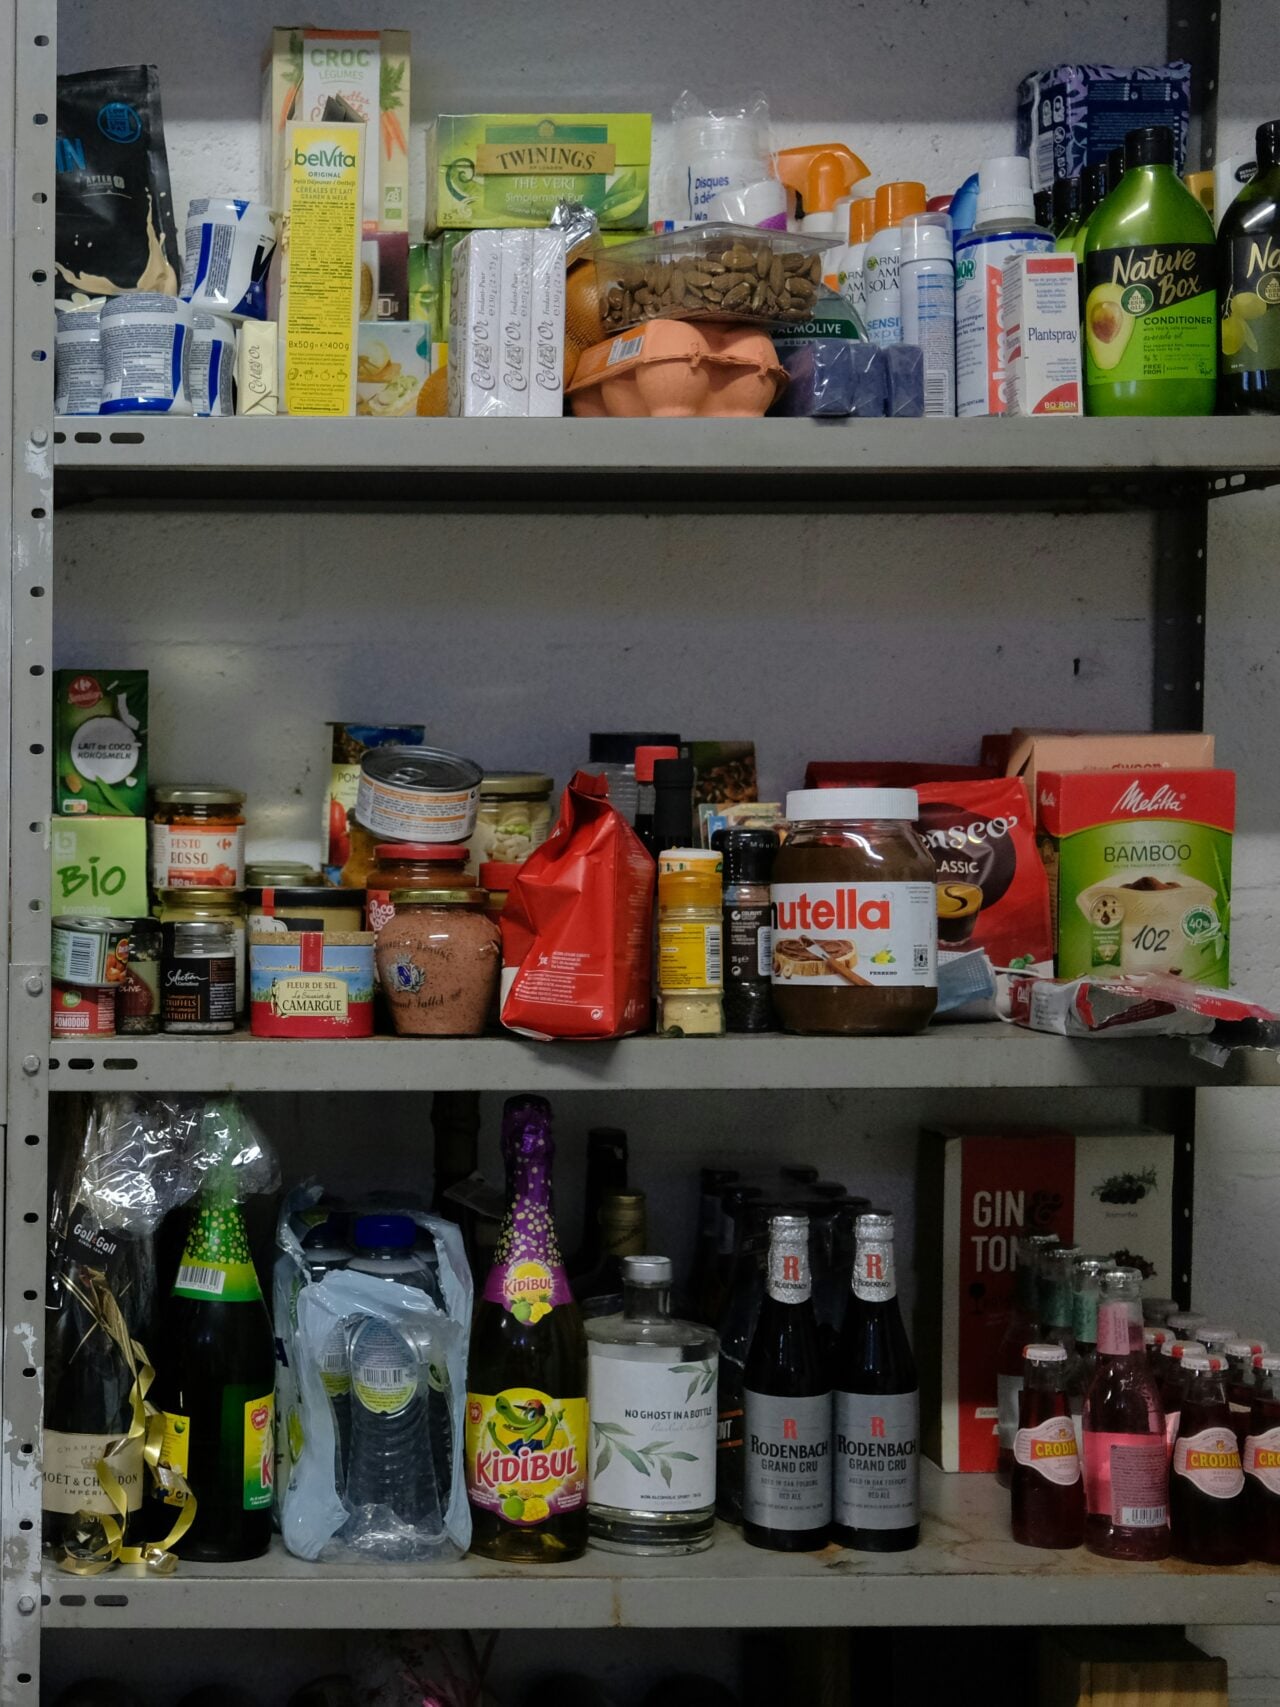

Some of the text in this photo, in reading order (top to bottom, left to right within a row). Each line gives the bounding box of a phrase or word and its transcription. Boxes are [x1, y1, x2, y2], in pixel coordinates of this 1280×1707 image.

[311, 49, 370, 68] CROC
[294, 145, 357, 169] belVita
[496, 144, 597, 171] TWININGS
[542, 176, 577, 189] VERT
[695, 177, 730, 190] Disques
[1112, 248, 1197, 287] Nature
[1159, 273, 1202, 305] Box
[1143, 315, 1213, 326] CONDITIONER
[1027, 327, 1078, 343] Plantspray
[77, 742, 132, 751] LAIT COCO
[77, 751, 132, 760] KOKOSMELK
[1110, 779, 1184, 814] Melitta
[171, 851, 209, 865] ROSSO
[1103, 843, 1192, 863] BAMBOO
[1131, 924, 1171, 951] 102
[286, 981, 338, 989] FLEUR DE SEL
[282, 999, 342, 1012] CAMARGUE
[972, 1189, 1025, 1228] GIN
[783, 1254, 800, 1282] R
[866, 1253, 883, 1280] R
[774, 1280, 808, 1290] RODENBACH
[858, 1279, 892, 1289] RODENBACH
[624, 1406, 712, 1420] NO GHOST IN A BOTTLE
[783, 1418, 798, 1440] R
[870, 1416, 886, 1439] R
[751, 1434, 829, 1459] RODENBACH
[838, 1434, 917, 1457] RODENBACH
[761, 1460, 818, 1474] GRAND CRU
[848, 1458, 907, 1472] GRAND CRU
[73, 1475, 81, 1486] &
[778, 1491, 802, 1500] RED ALE
[867, 1490, 891, 1499] RED ALE
